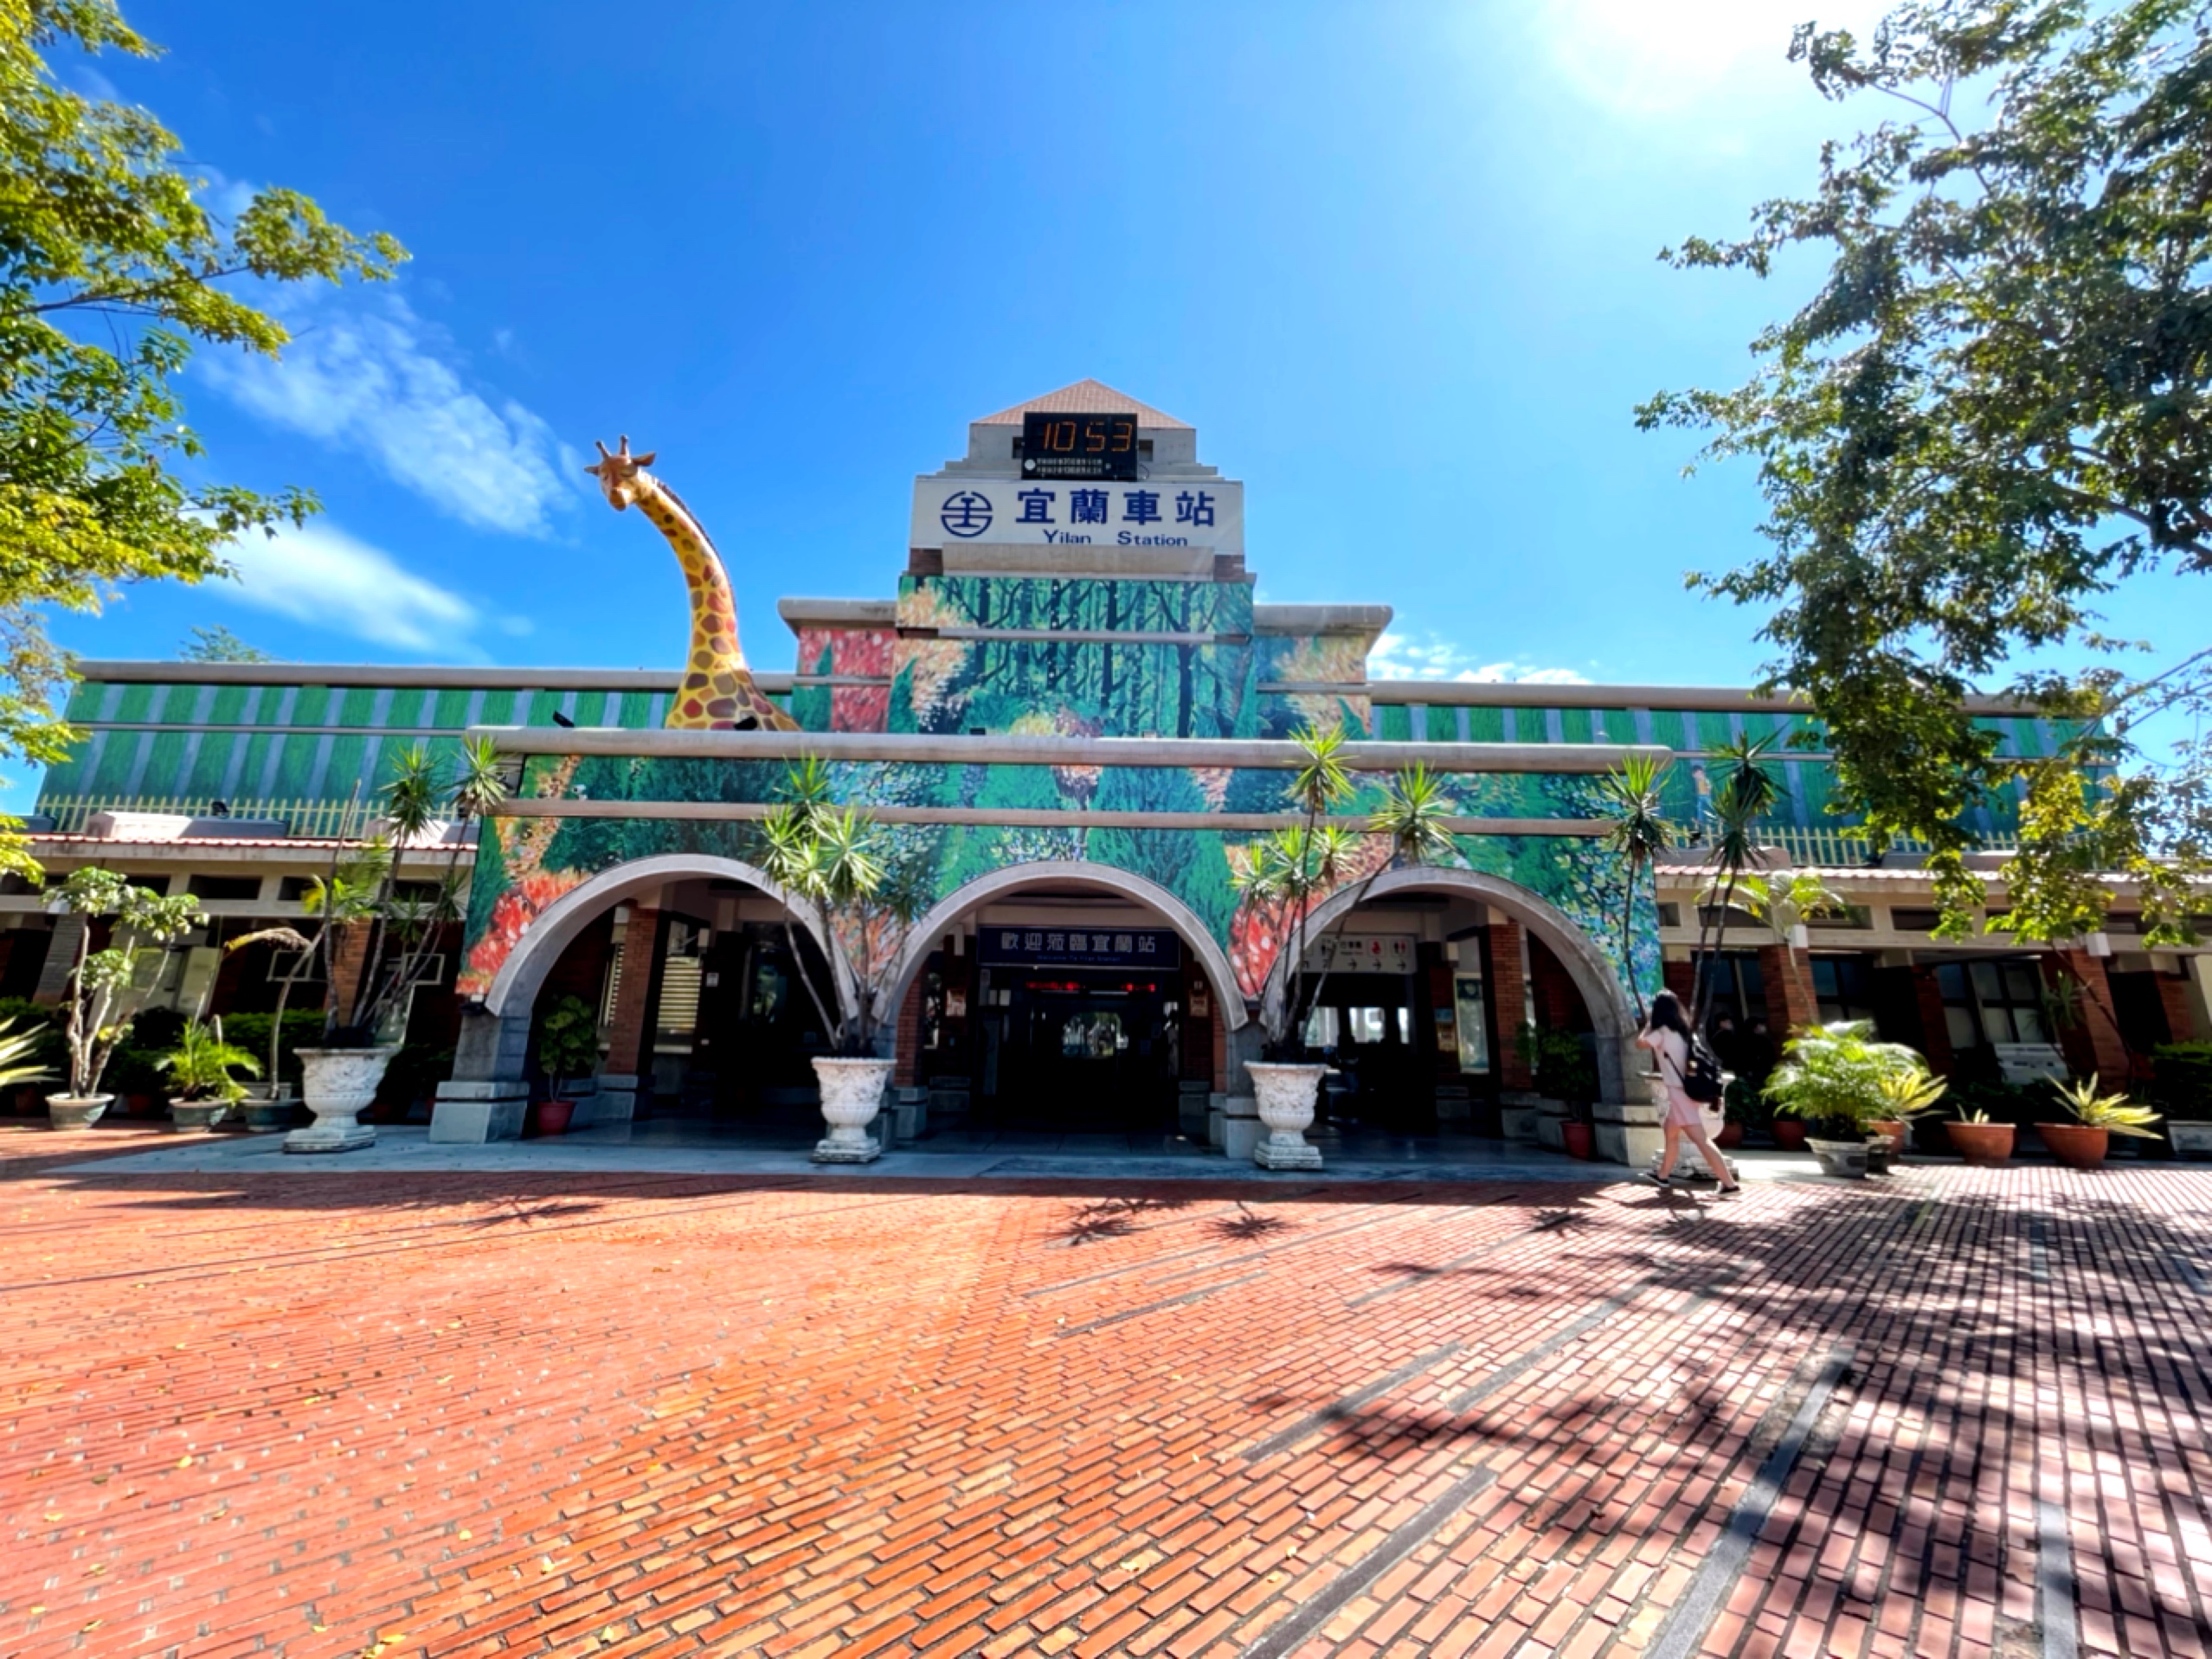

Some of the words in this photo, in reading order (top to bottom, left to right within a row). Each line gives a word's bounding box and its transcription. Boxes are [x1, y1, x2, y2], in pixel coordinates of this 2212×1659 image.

[1015, 487, 1215, 527] 宜蘭車站
[1043, 528, 1091, 545] Yilan
[1116, 530, 1188, 547] Station
